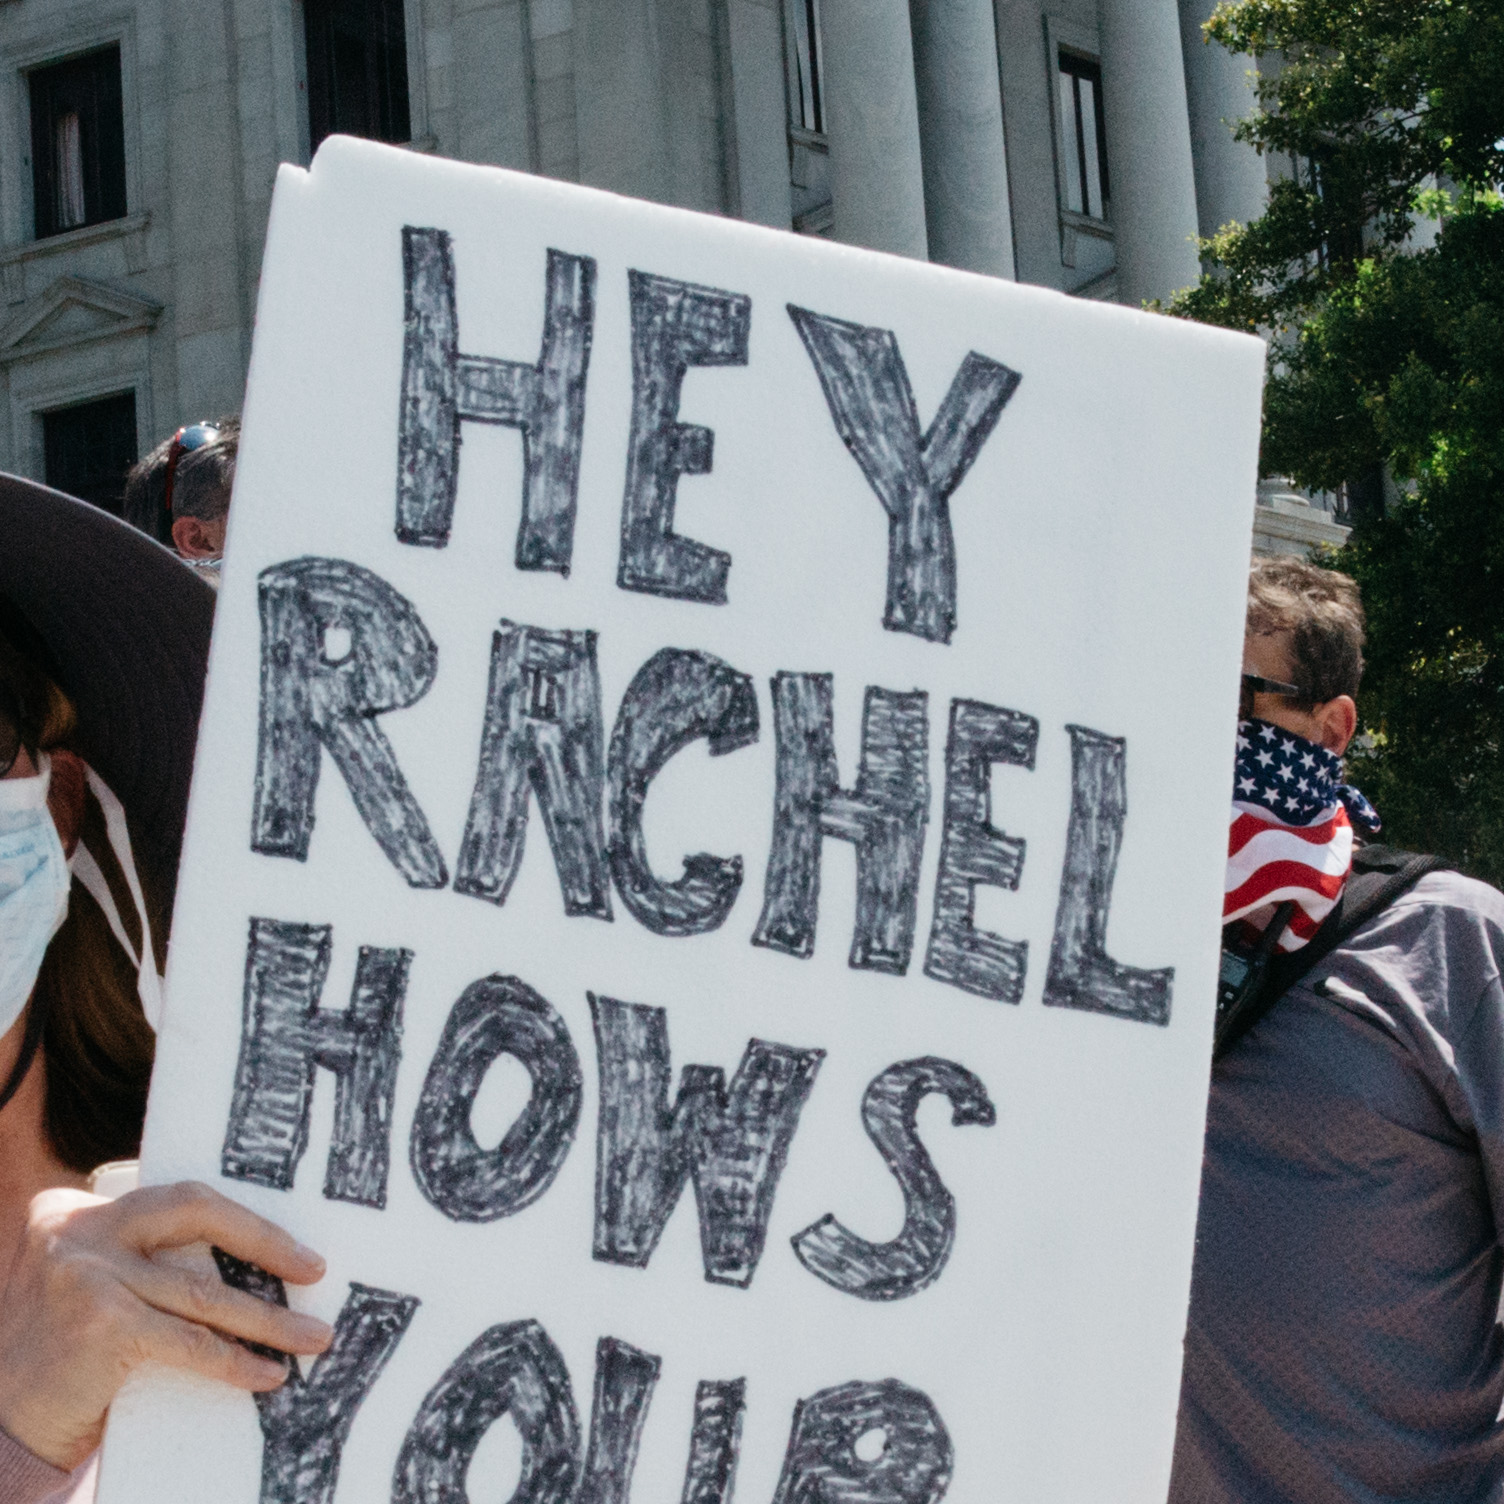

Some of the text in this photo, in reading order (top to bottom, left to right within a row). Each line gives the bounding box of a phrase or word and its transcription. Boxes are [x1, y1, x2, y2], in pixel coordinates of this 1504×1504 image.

[393, 224, 1024, 645] HEY
[250, 554, 1177, 1028] RACHEL
[220, 915, 998, 1302] HOWS
